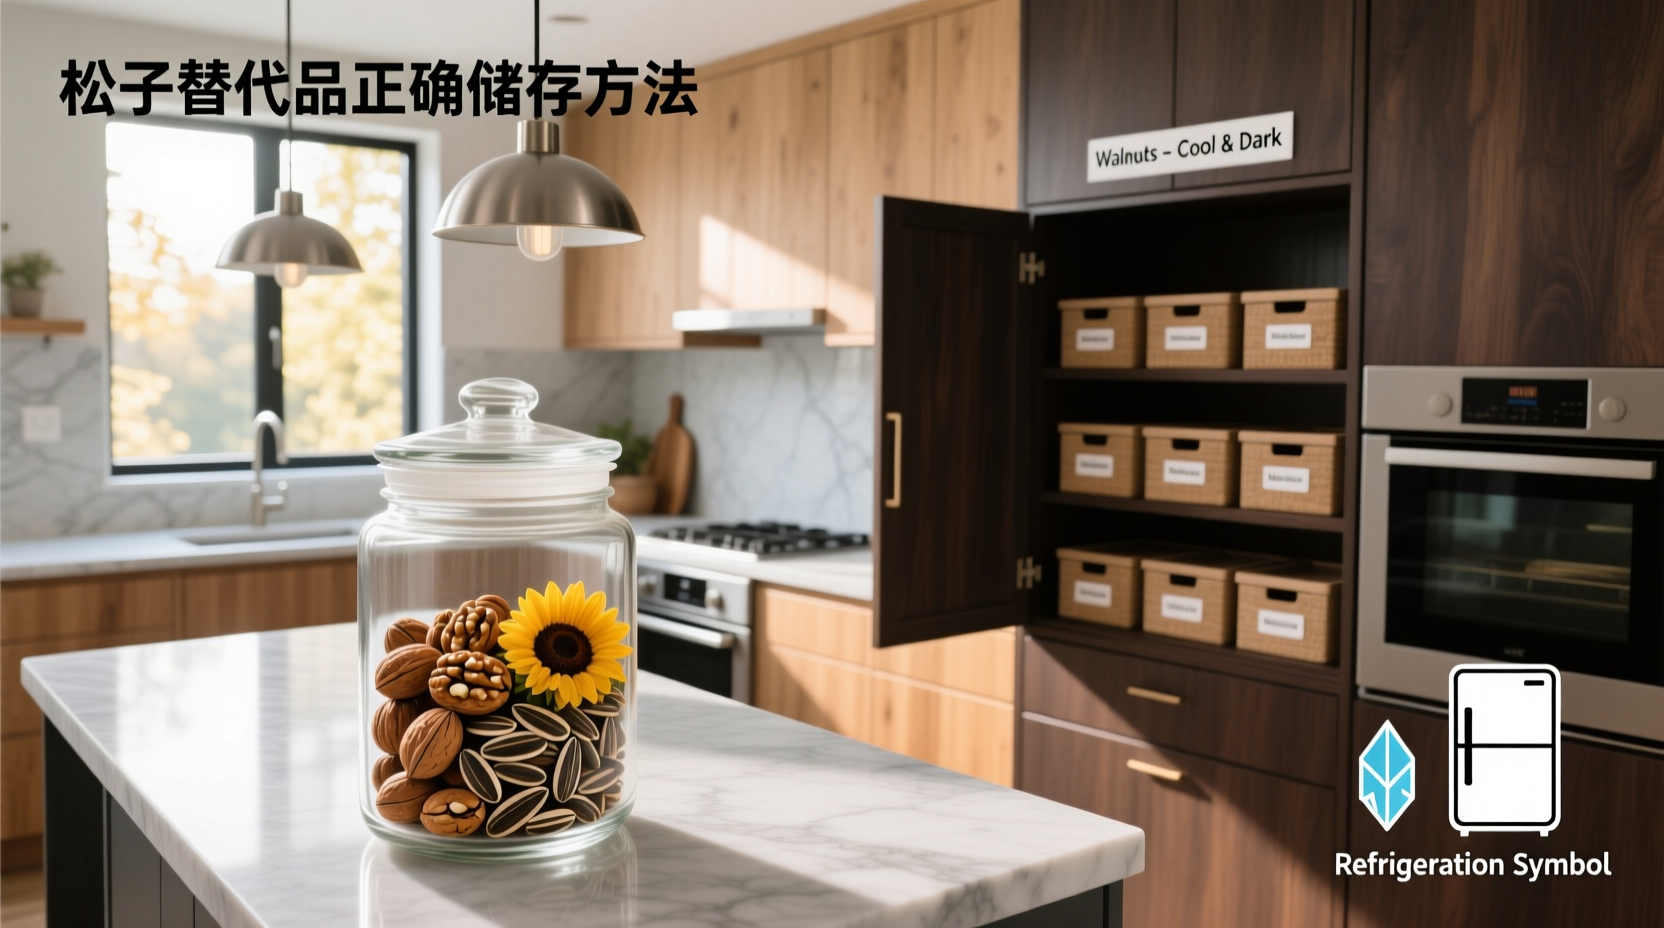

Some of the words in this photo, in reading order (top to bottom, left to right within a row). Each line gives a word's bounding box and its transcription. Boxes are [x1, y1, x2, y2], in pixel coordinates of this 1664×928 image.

[1096, 146, 1157, 168] Walnuts
[1178, 135, 1215, 158] Cool
[1221, 134, 1233, 153] &
[1240, 127, 1282, 150] Dark
